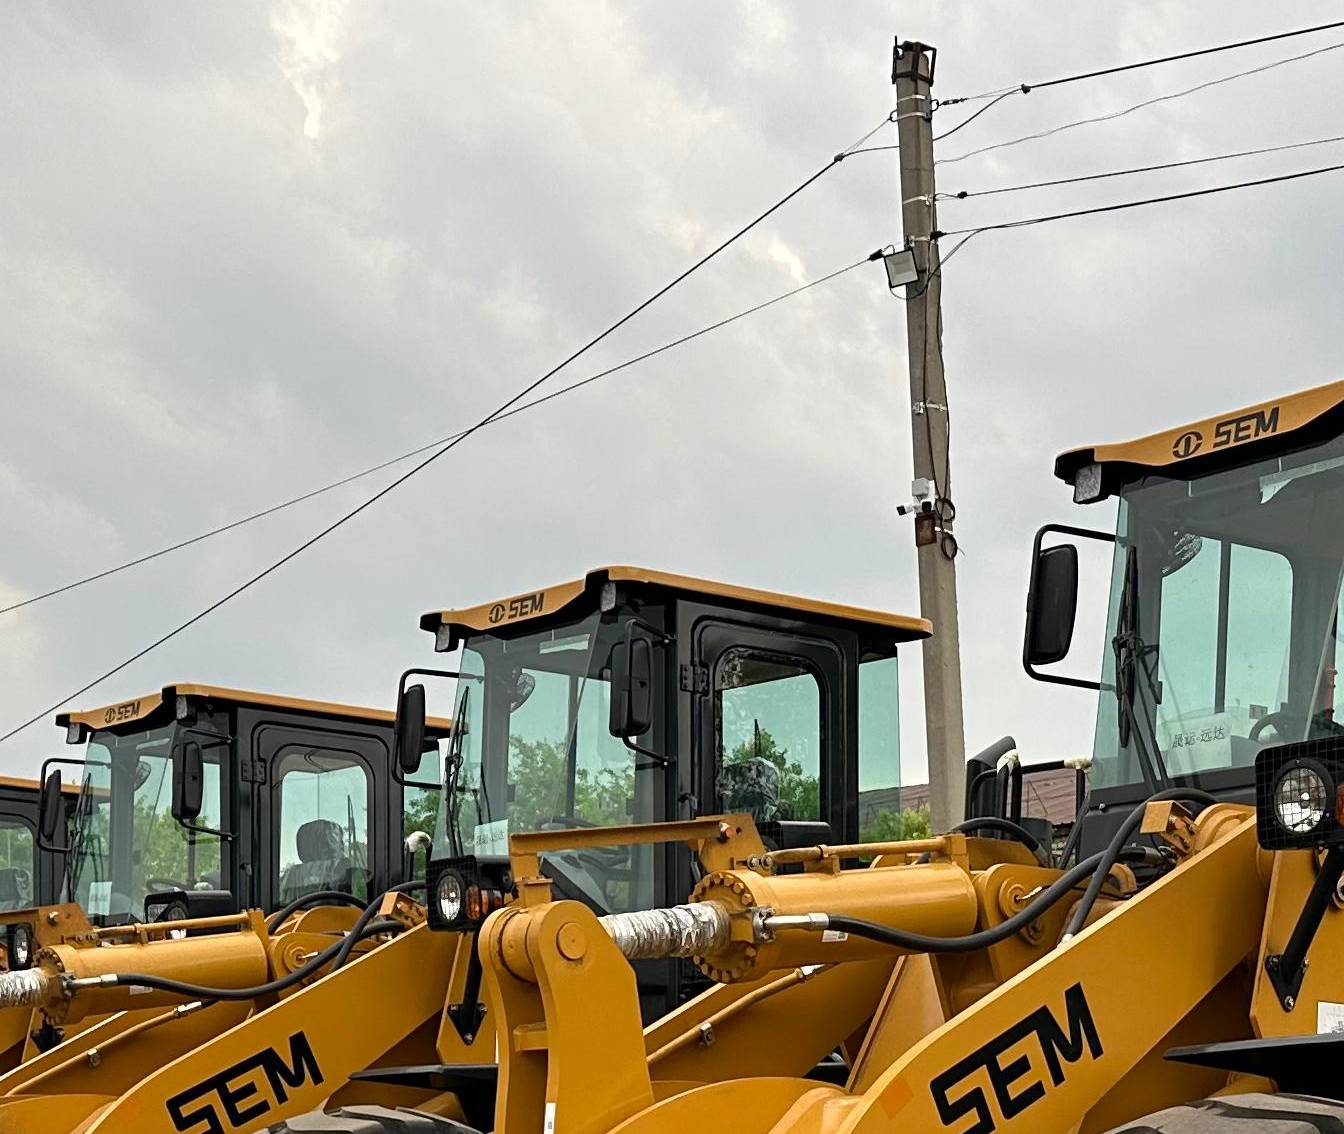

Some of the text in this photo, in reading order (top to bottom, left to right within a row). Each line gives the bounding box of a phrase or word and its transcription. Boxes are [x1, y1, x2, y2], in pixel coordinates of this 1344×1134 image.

[1213, 406, 1280, 449] SEM
[507, 592, 546, 620] SEM
[116, 700, 141, 720] SEM
